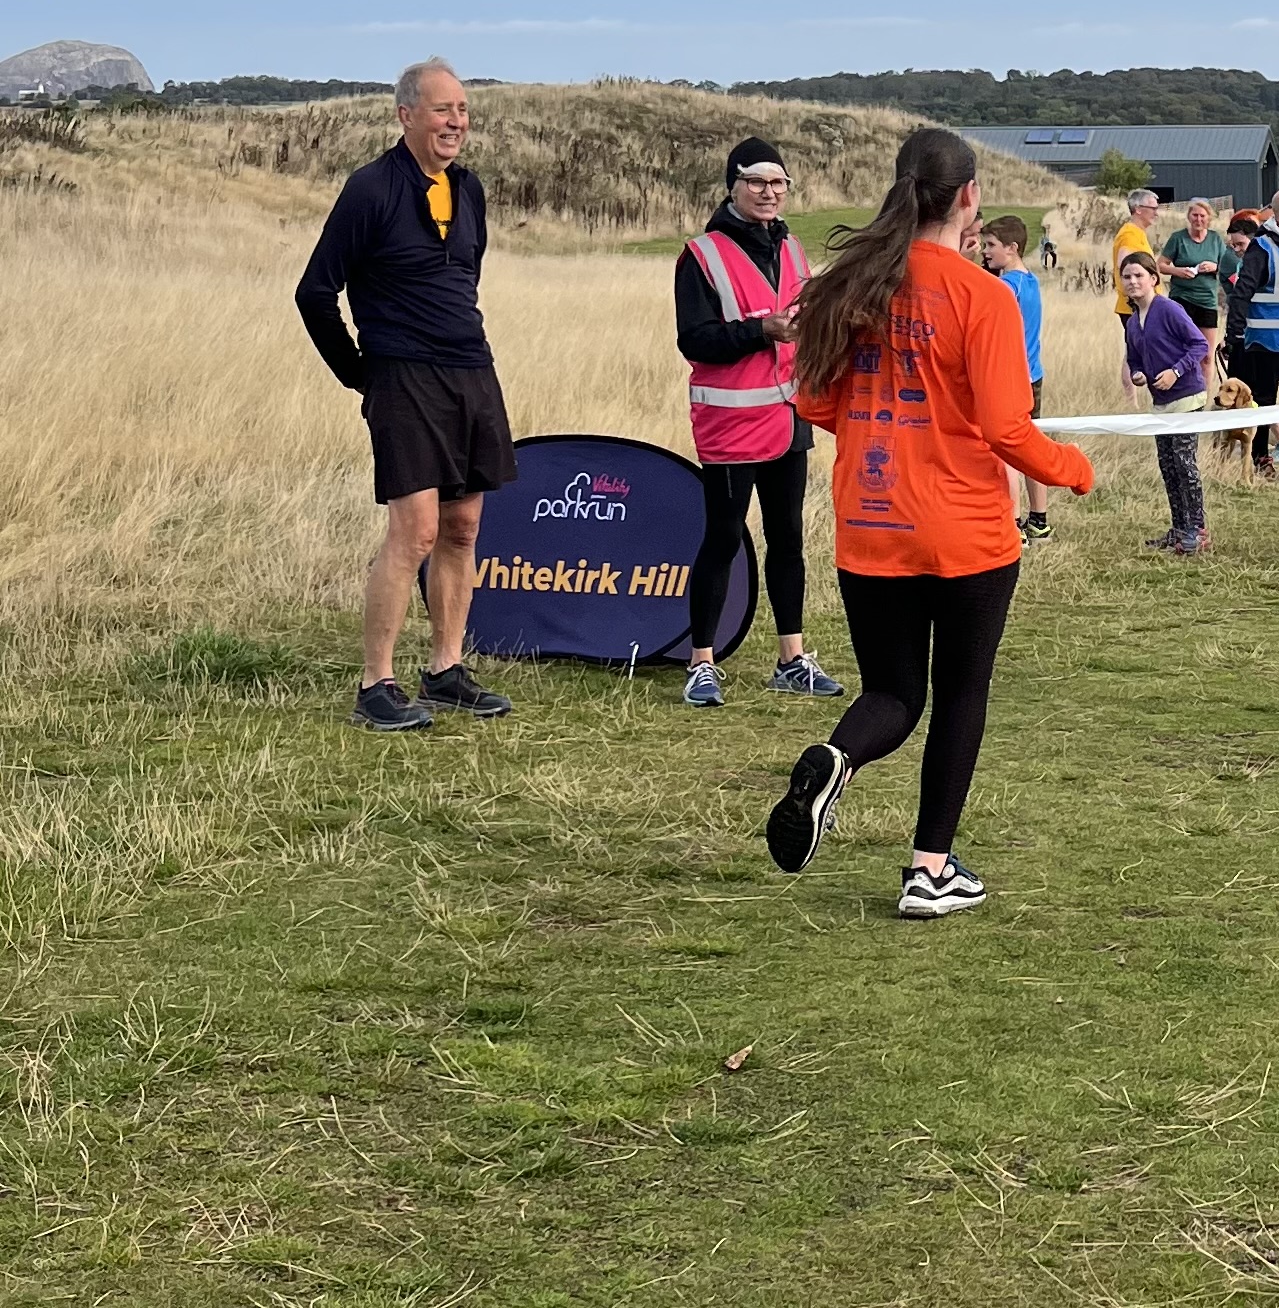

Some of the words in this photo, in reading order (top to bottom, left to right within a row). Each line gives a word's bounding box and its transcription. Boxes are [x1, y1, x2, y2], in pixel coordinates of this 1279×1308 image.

[532, 477, 627, 523] parkrun
[592, 473, 631, 499] Vitality
[628, 562, 691, 597] Hill
